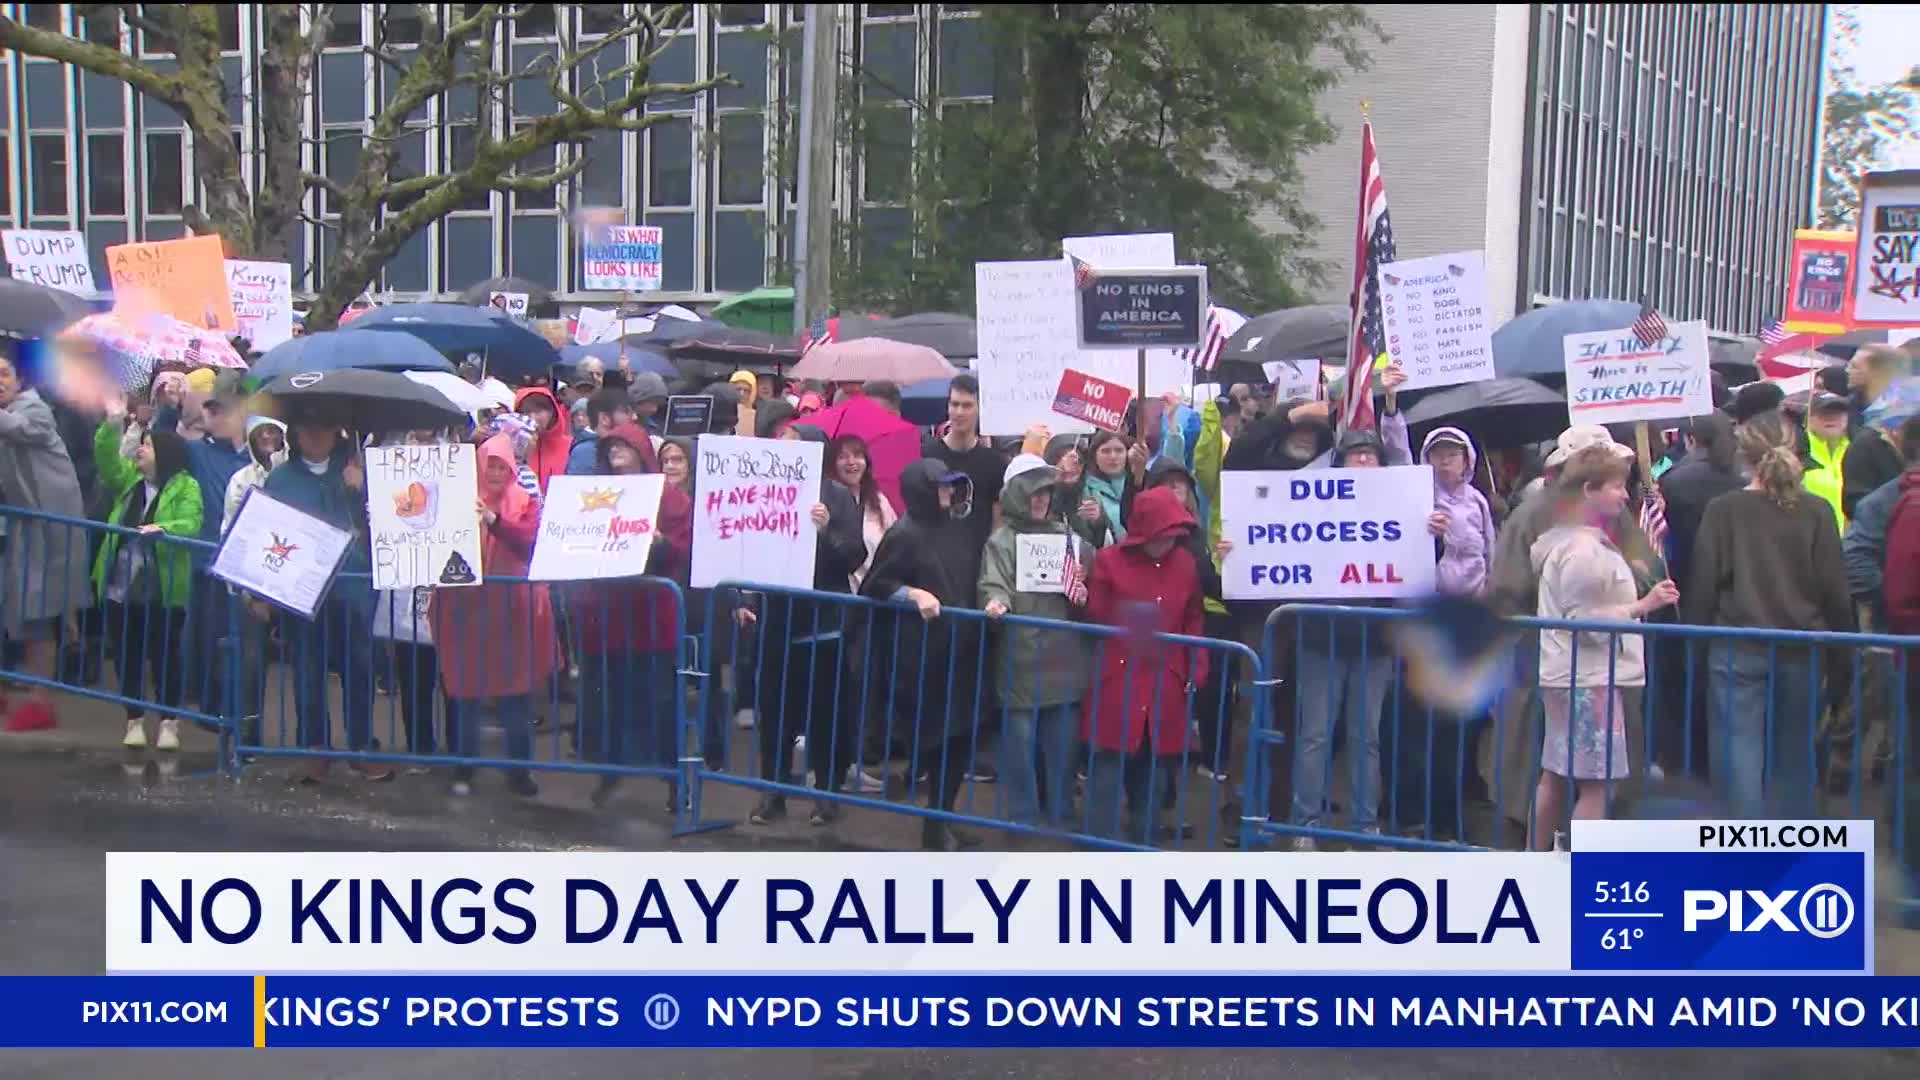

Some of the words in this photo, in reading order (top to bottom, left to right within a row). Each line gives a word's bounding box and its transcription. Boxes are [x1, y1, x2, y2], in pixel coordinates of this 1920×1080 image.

[628, 231, 659, 244] WHAT
[16, 237, 75, 256] DUMP
[588, 245, 659, 260] DEMOCRACY
[1872, 236, 1919, 264] SAY
[587, 261, 626, 276] LOOKS
[631, 262, 659, 277] LIKE
[1403, 274, 1449, 288] AMERICA
[1096, 284, 1122, 296] NO
[1128, 284, 1185, 296] KINGS
[1406, 292, 1421, 300] NO
[509, 299, 523, 310] NO
[1132, 298, 1150, 308] IN
[1100, 311, 1182, 322] AMERICA
[1435, 307, 1482, 321] DICTATOR
[1437, 339, 1460, 348] HATE
[1580, 340, 1607, 359] IN
[1616, 336, 1682, 355] UNTY
[1439, 348, 1484, 360] VIOLENCE
[1418, 367, 1432, 376] NO
[1635, 362, 1648, 374] is
[1083, 381, 1105, 399] NO
[1085, 404, 1121, 426] KING
[376, 462, 458, 480] THRONE
[704, 451, 730, 476] We
[761, 450, 809, 483] People
[1290, 479, 1355, 501] DUE
[707, 486, 758, 514] HAVE
[762, 484, 798, 506] HAD
[607, 515, 650, 539] KINGS
[720, 509, 799, 540] ENOUGH!
[1247, 520, 1402, 545] PROCESS
[1250, 564, 1312, 586] FOR
[1340, 562, 1403, 584] ALL
